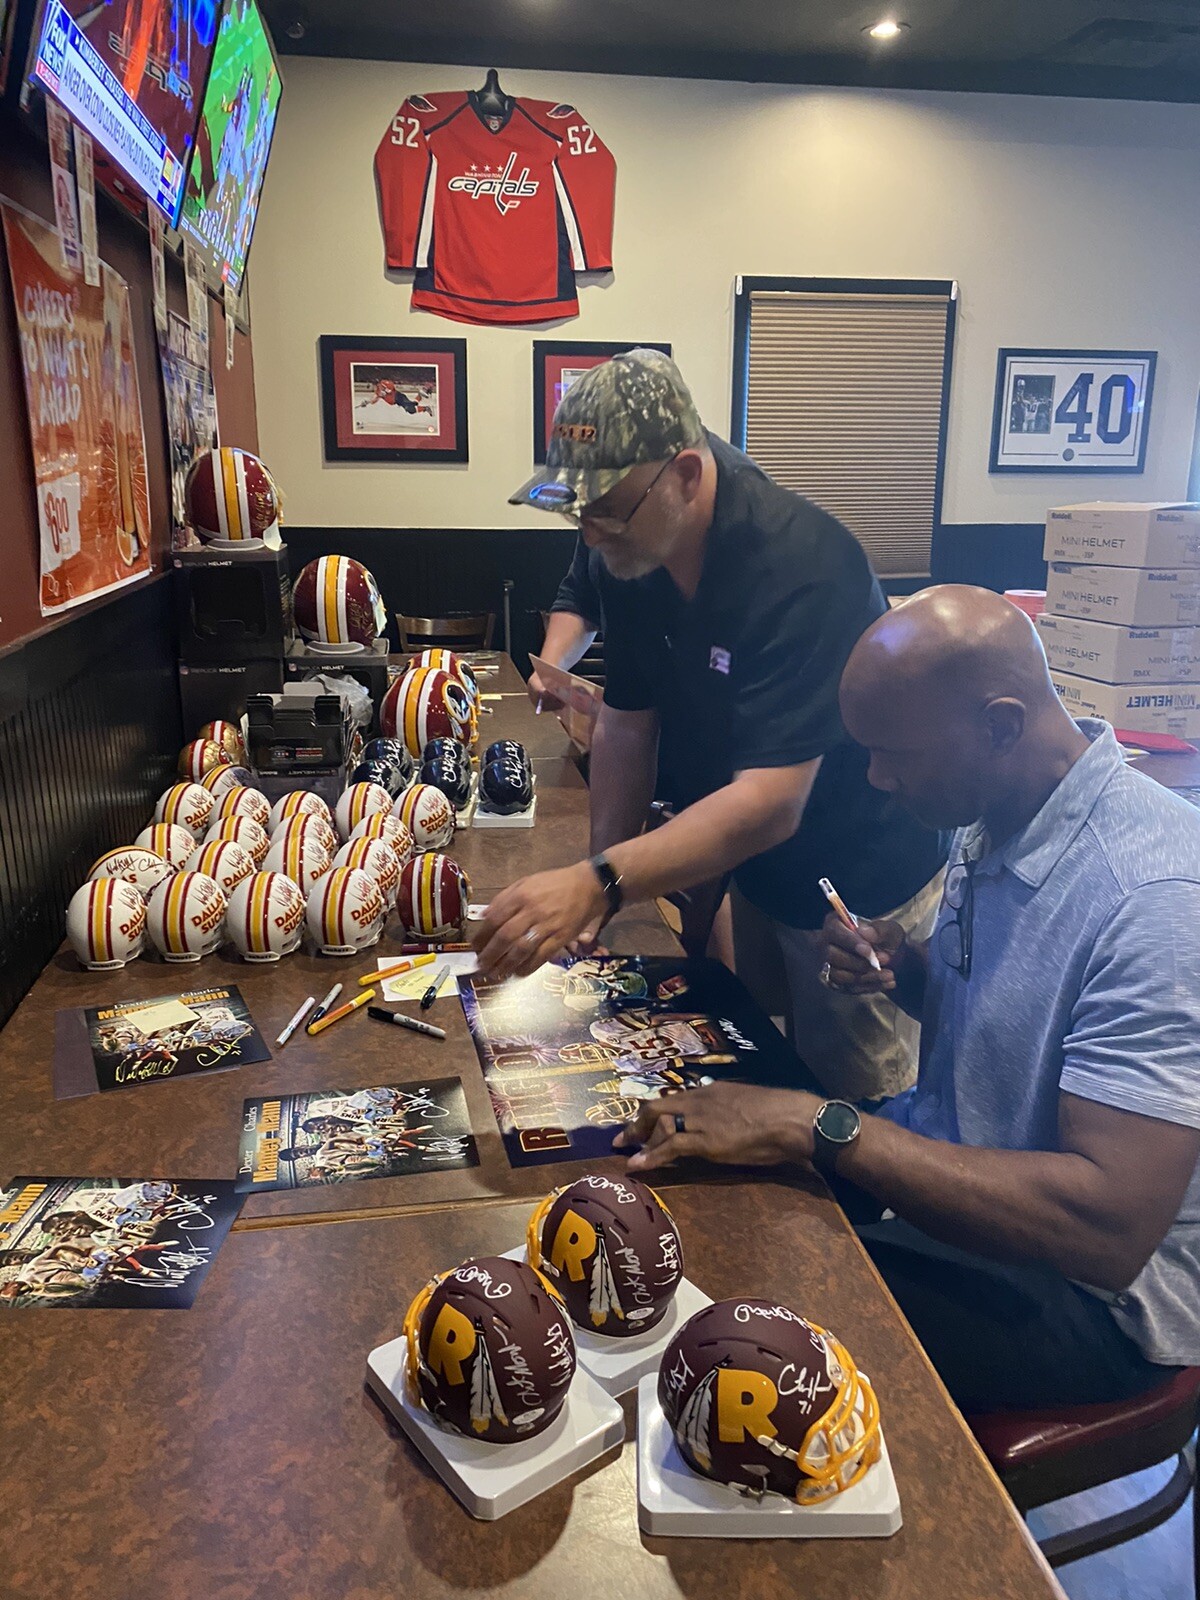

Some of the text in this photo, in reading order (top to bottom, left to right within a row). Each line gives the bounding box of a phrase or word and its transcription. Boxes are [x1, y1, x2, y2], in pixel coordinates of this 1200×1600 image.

[50, 22, 66, 53] FOX
[42, 41, 63, 78] NEWS
[391, 116, 421, 149] 52
[567, 124, 597, 155] 52
[1055, 373, 1135, 444] 40
[1061, 535, 1126, 549] MINI HELMET
[1062, 590, 1119, 606] MINI HELMET
[1129, 631, 1160, 639] Riddell
[1065, 648, 1101, 662] HELMET
[1170, 656, 1200, 664] HELM
[1127, 695, 1173, 709] HELMET
[420, 804, 448, 828] DALLAS
[120, 906, 145, 935] DALL
[191, 892, 224, 927] DALLAS
[275, 893, 305, 928] DALLAS
[351, 889, 383, 922] DALLAS
[128, 924, 145, 942] SUC
[113, 987, 221, 1010] Dexter Charles
[178, 990, 230, 1006] Mann
[629, 1036, 681, 1060] 65
[257, 1100, 281, 1134] Mann
[239, 1106, 258, 1175] Dexter Charles
[0, 1183, 48, 1224] Mann
[551, 1209, 597, 1283] R
[428, 1302, 476, 1386] R
[717, 1368, 778, 1443] R
